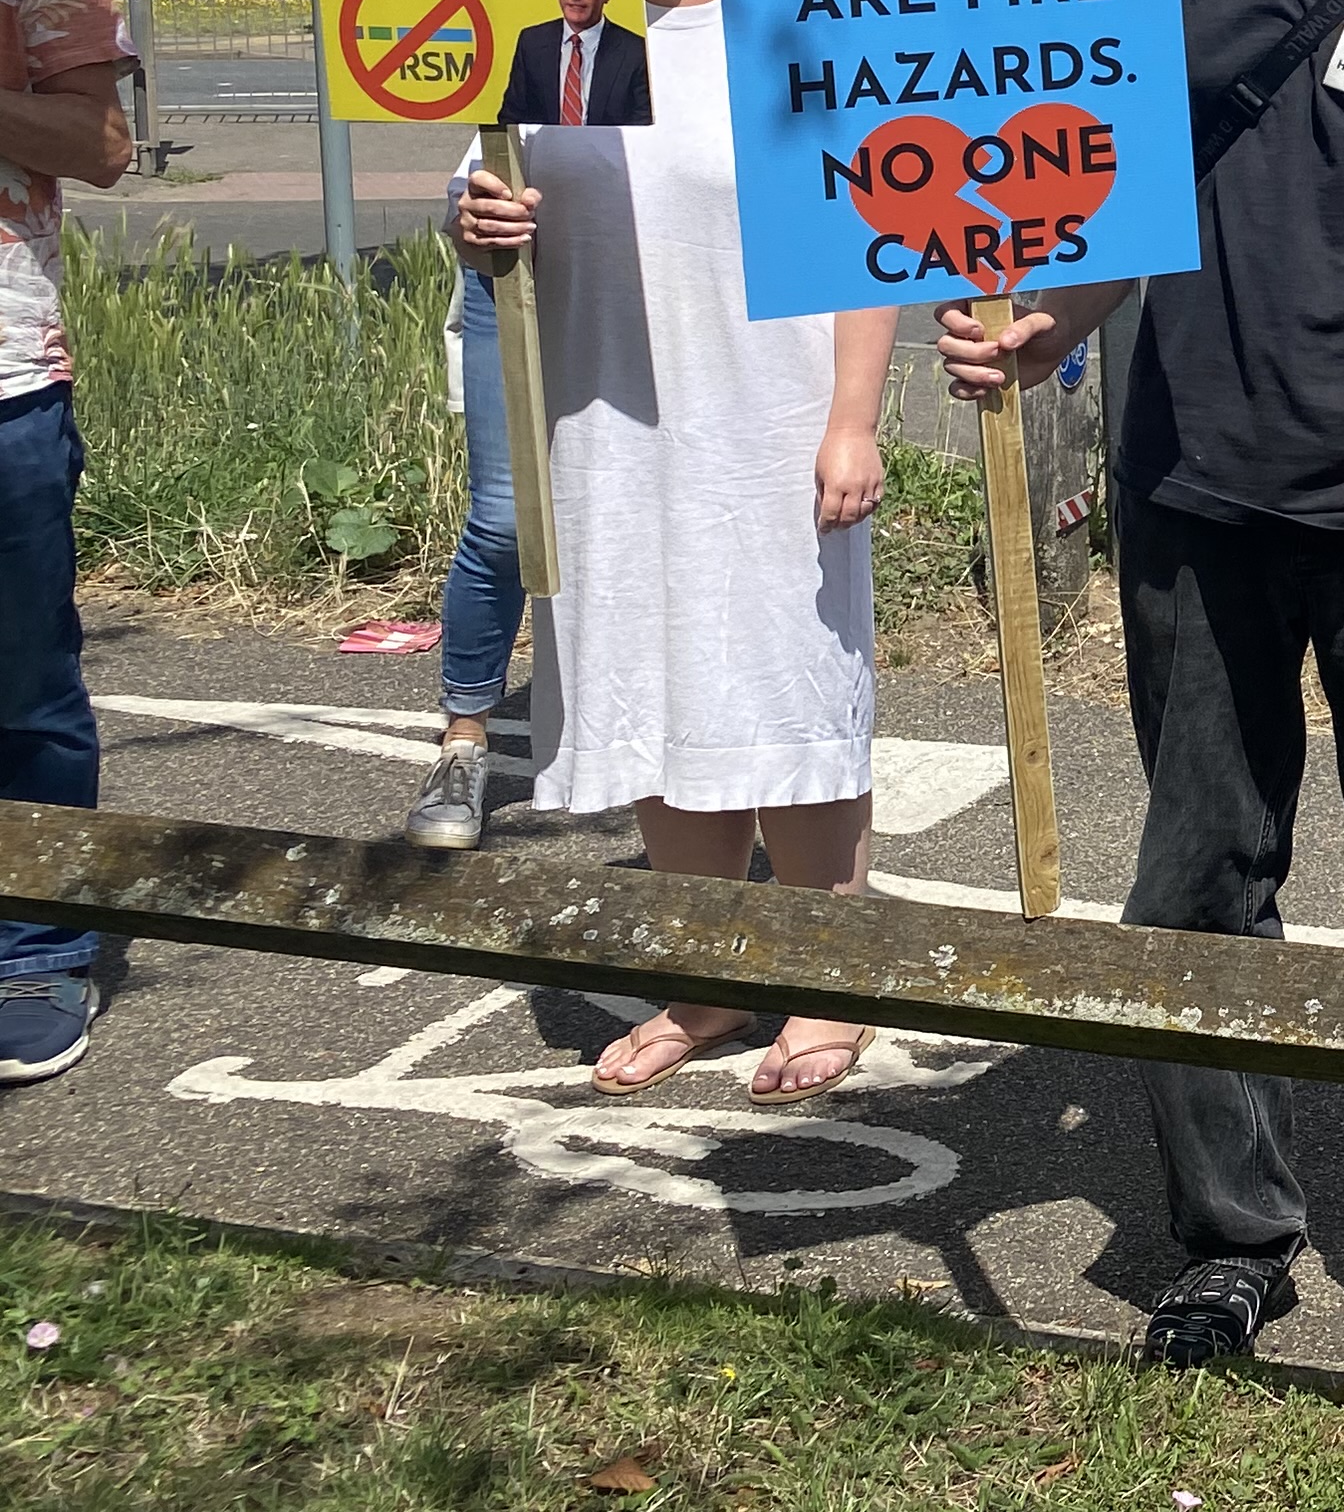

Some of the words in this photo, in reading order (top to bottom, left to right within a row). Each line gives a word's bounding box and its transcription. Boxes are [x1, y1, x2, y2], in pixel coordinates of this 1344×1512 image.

[400, 52, 474, 82] RSM
[788, 37, 1138, 114] HAZARDS.
[822, 143, 934, 200] NO
[963, 124, 1117, 184] ONE
[866, 214, 1087, 283] CARES
